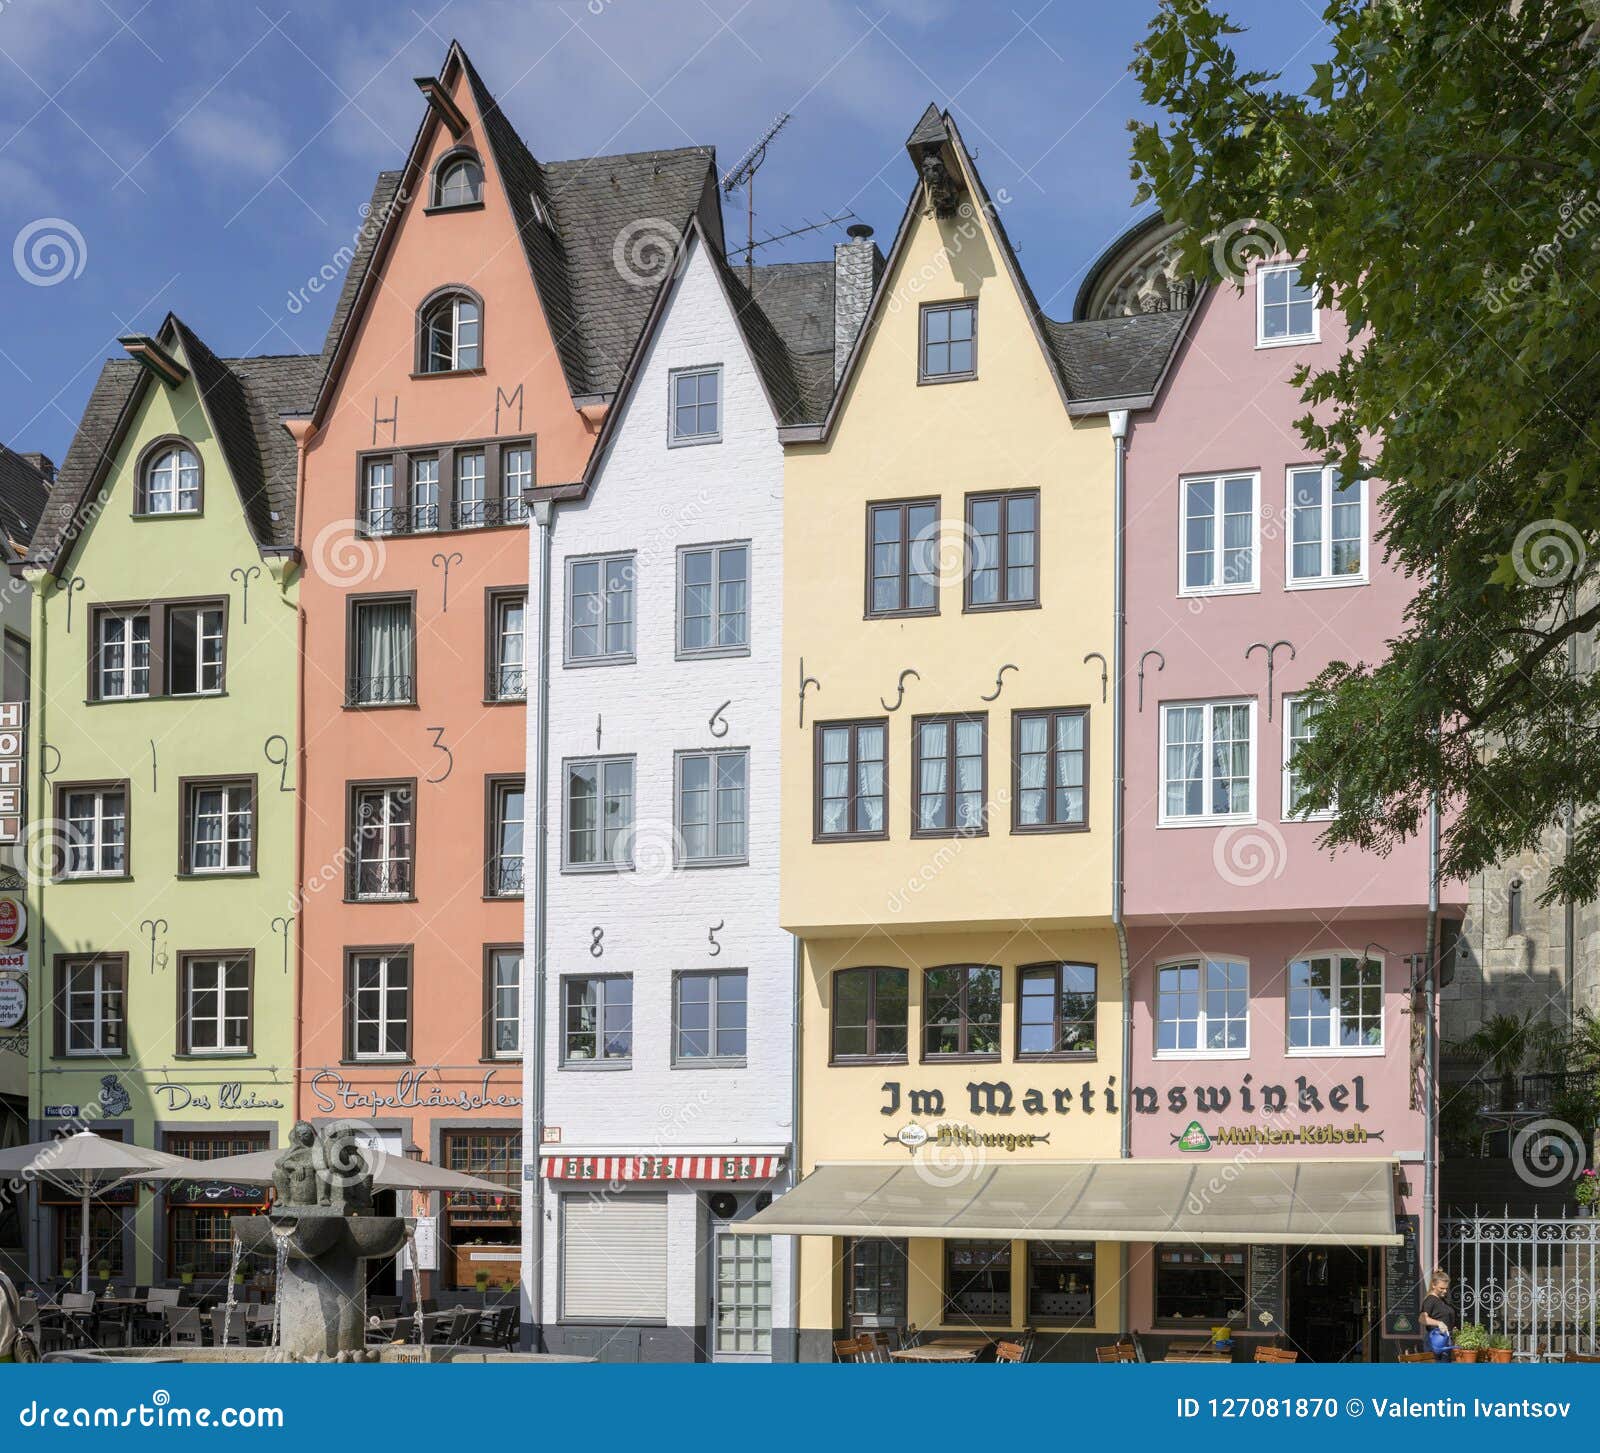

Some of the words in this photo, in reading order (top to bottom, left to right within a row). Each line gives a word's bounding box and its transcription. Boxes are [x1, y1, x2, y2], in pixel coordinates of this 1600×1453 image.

[495, 384, 523, 435] M
[709, 700, 731, 738] 6
[0, 705, 18, 841] HOTEL
[590, 926, 604, 957] 8
[708, 919, 724, 956] 5
[0, 954, 24, 967] otel
[154, 1083, 211, 1111] Das
[311, 1069, 523, 1117] Stapelhäuschen
[966, 1073, 1370, 1117] Martinswinkel
[1216, 1125, 1294, 1145] Mühlen
[1299, 1123, 1368, 1144] Kölsch
[565, 1161, 595, 1177] Eis
[642, 1161, 673, 1177] Eis
[723, 1160, 753, 1177] Eis
